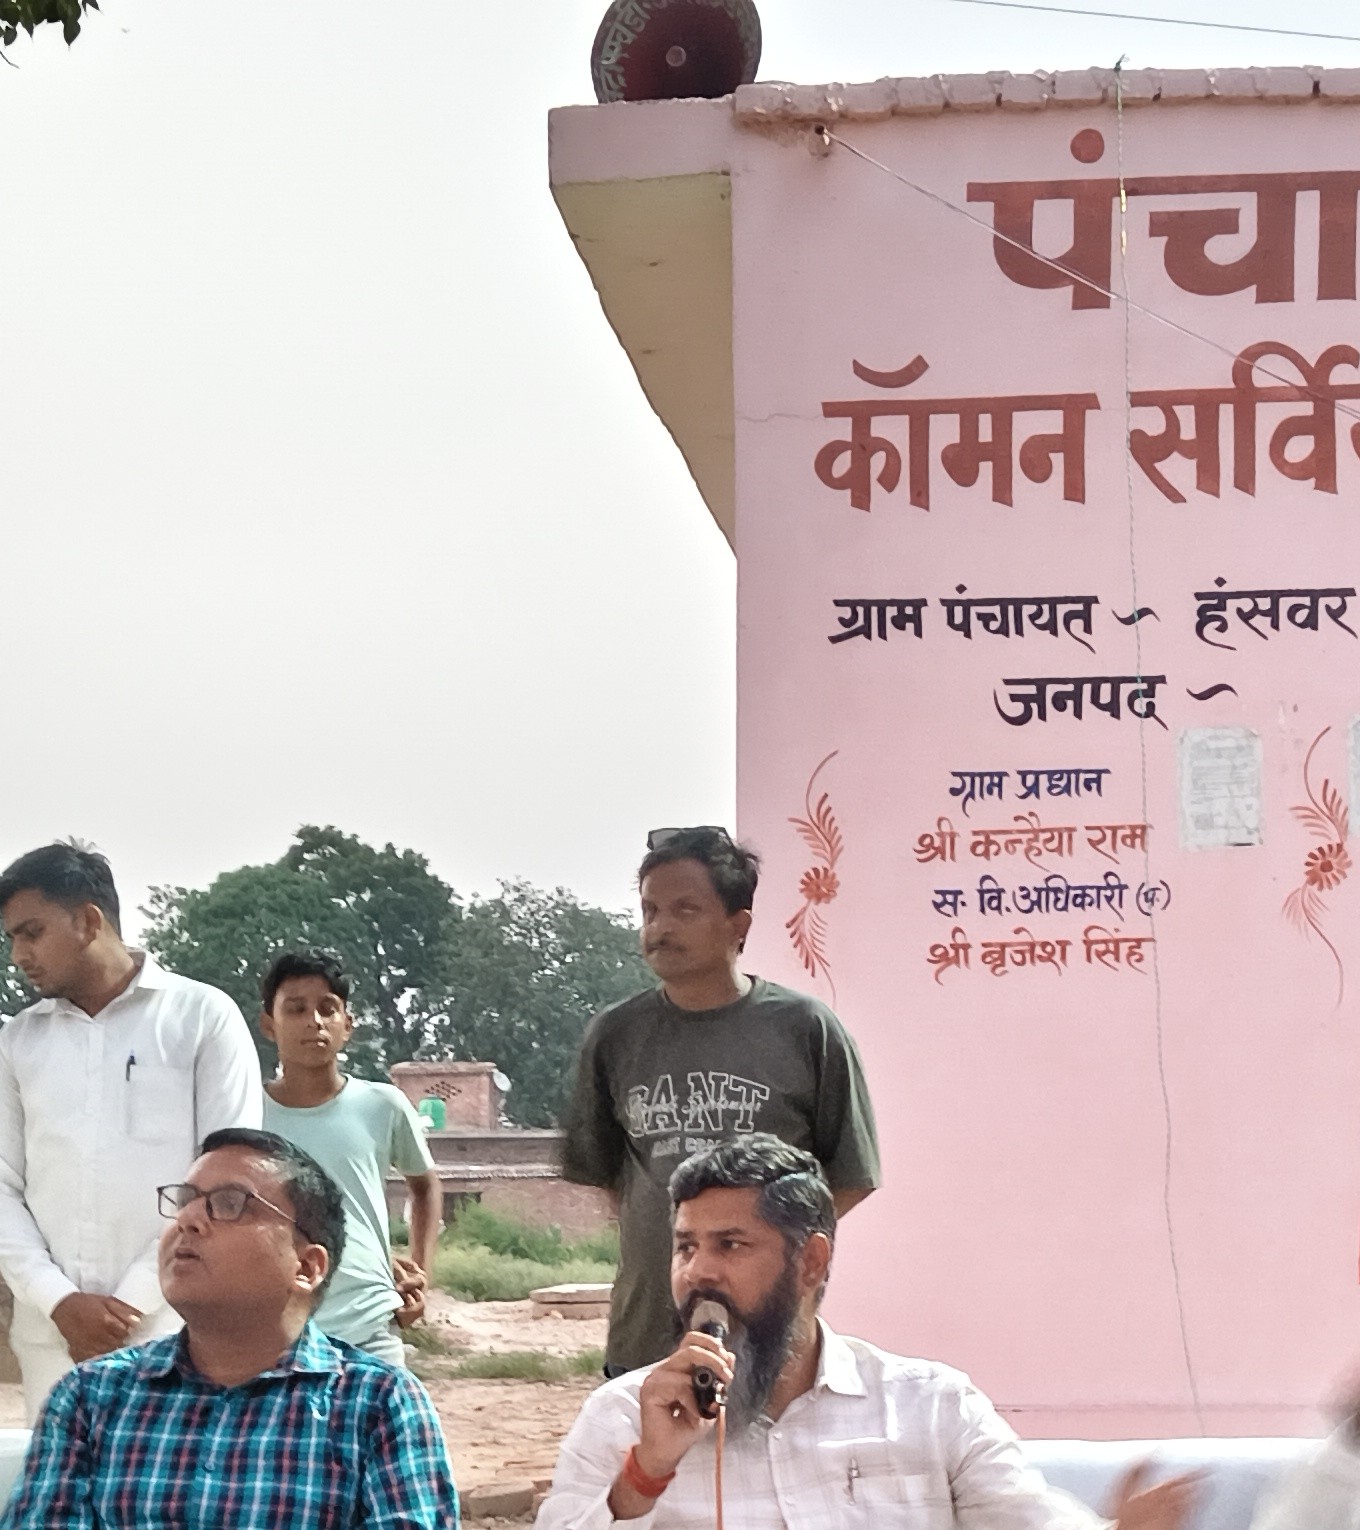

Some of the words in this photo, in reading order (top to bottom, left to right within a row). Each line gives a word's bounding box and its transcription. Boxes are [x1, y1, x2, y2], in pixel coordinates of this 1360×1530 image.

[814, 354, 1101, 512] कॉमन
[828, 597, 928, 644] ग्राम
[940, 583, 1100, 654] पंचायत
[1194, 576, 1358, 651] हंसवर
[994, 674, 1169, 730] जनपद
[949, 770, 1010, 818] ग्राम
[913, 816, 960, 864] श्री
[1084, 823, 1153, 864] राम
[927, 926, 972, 986] श्री
[1083, 924, 1156, 975] सिंह
